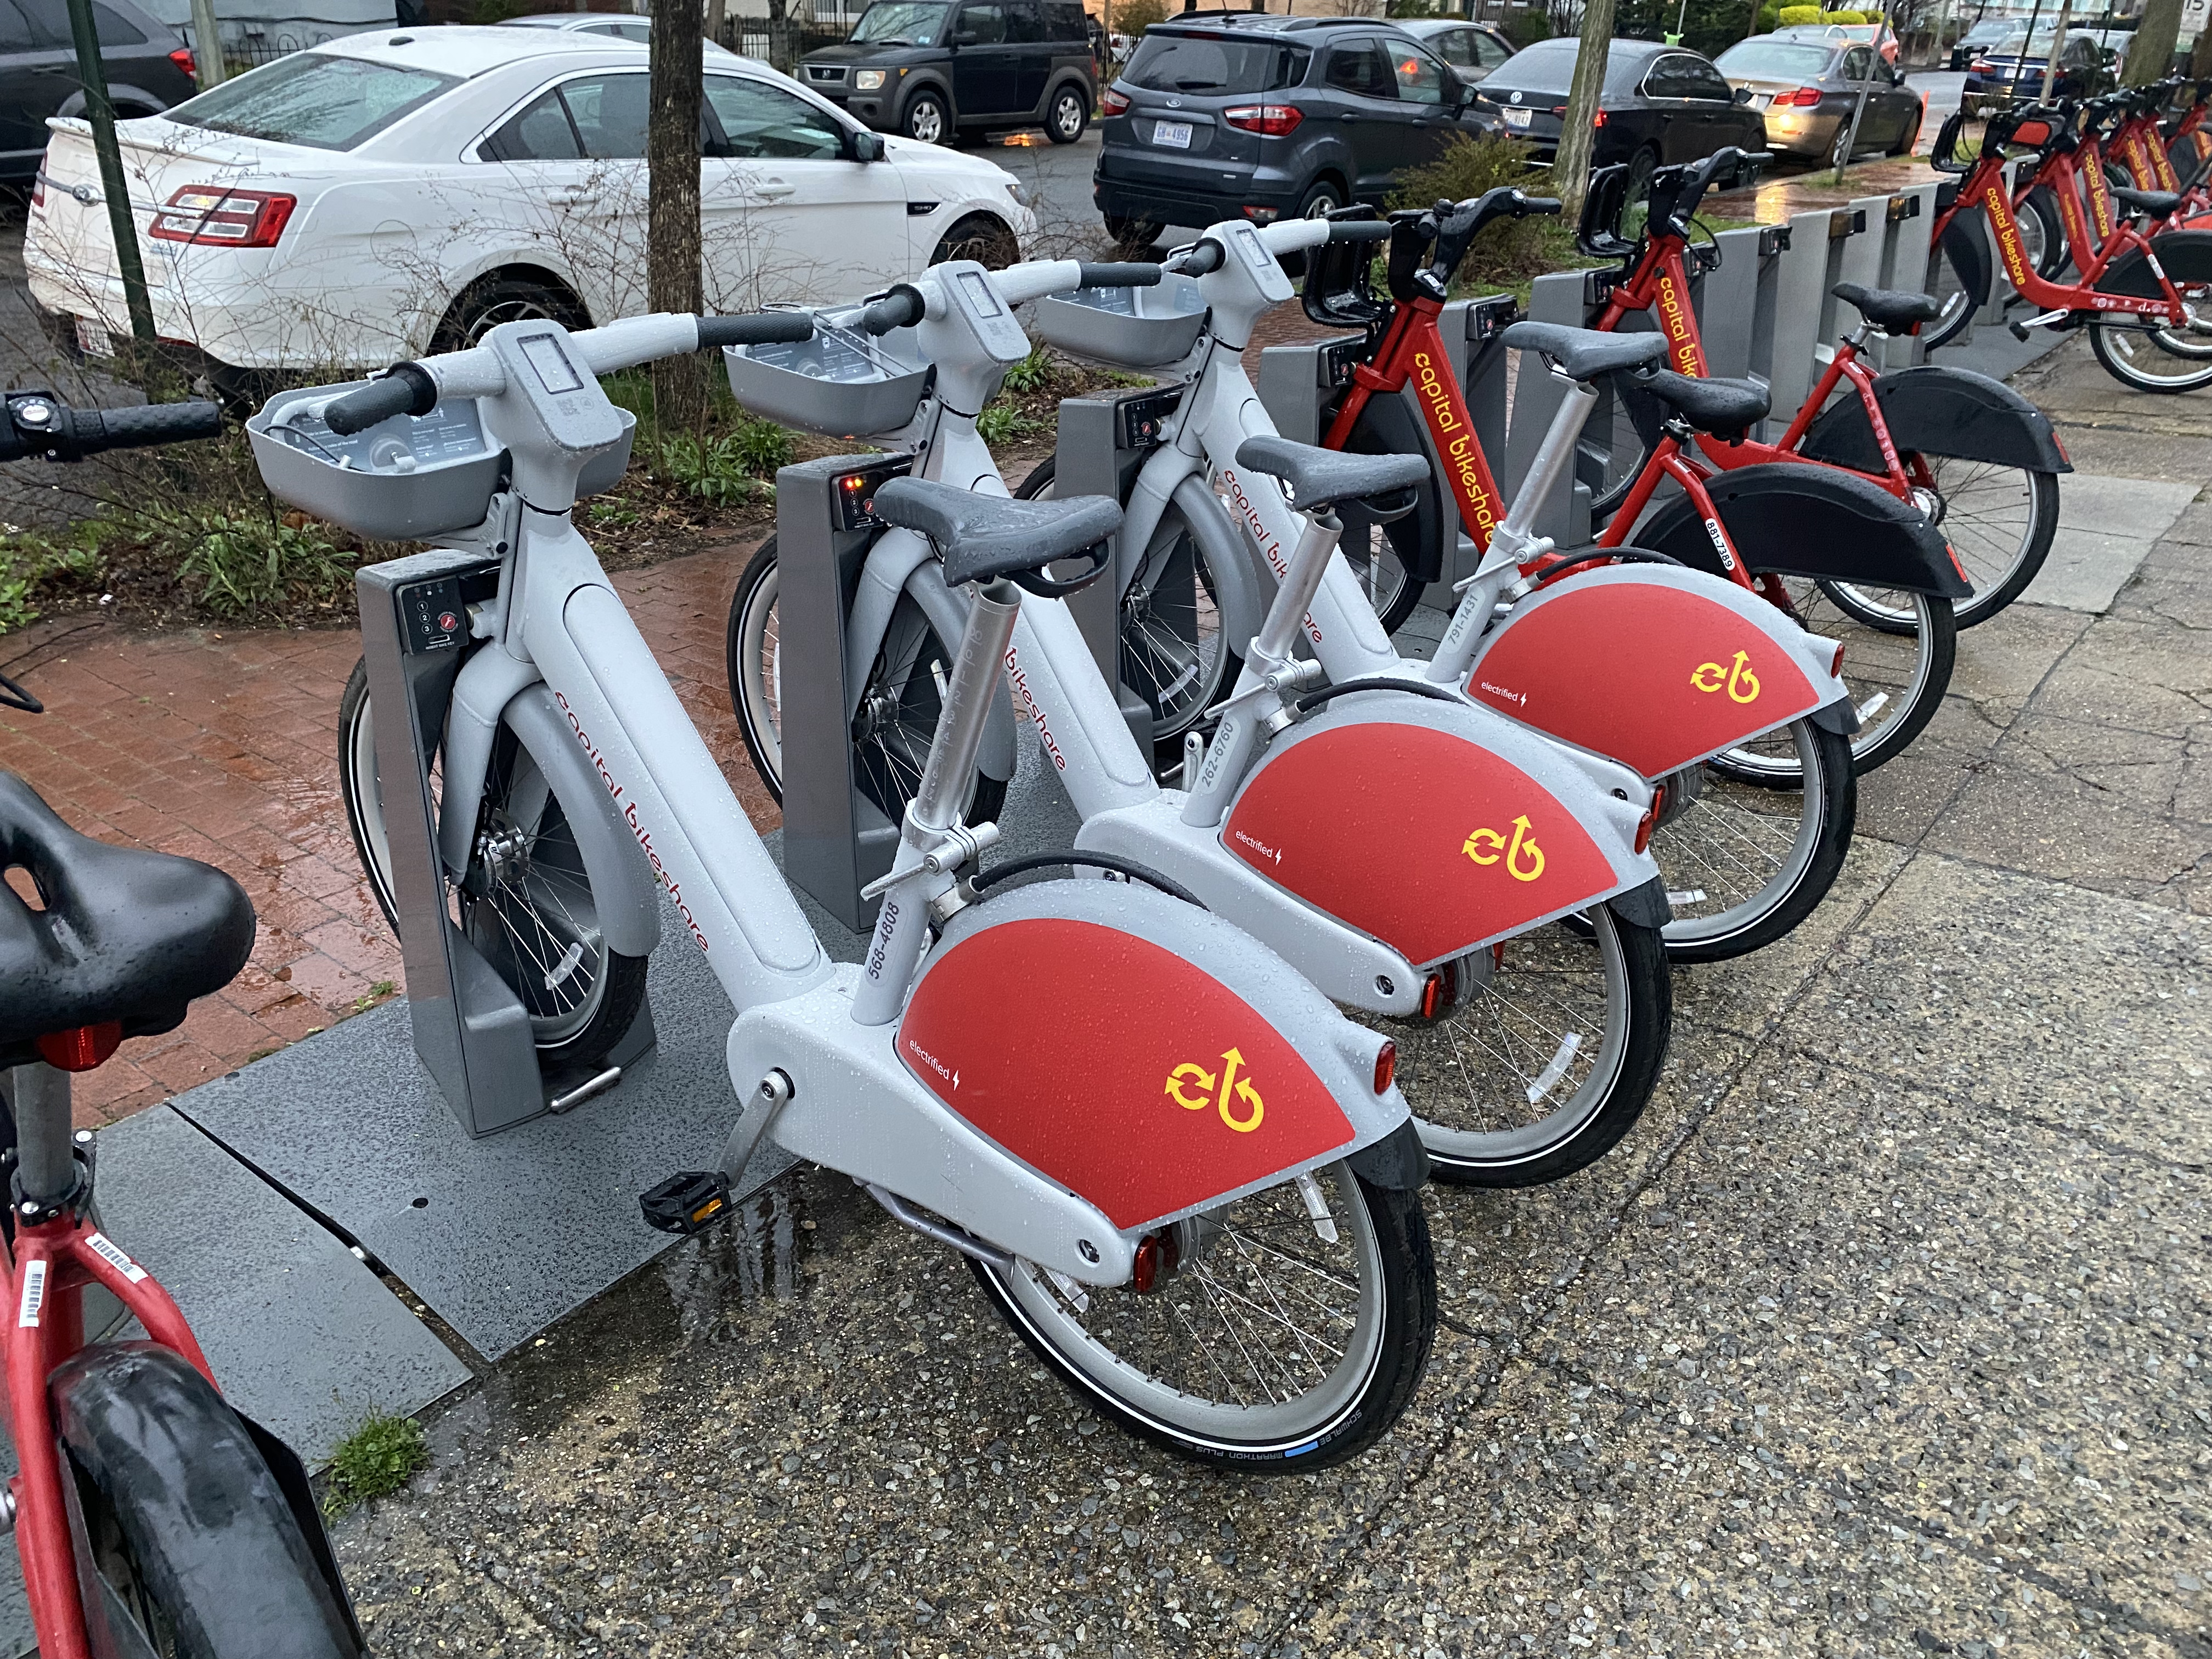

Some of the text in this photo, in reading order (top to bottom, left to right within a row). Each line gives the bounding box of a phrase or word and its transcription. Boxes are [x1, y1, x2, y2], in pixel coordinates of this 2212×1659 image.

[1987, 187, 2025, 285] capital bikeshare
[1661, 278, 1691, 341] capital
[1415, 353, 1462, 433] capital
[1224, 470, 1271, 542] capital
[1707, 522, 1733, 567] 881-7389
[1448, 594, 1478, 645] 791-1431
[1005, 647, 1065, 771] bikeshare
[1481, 681, 1519, 702] electrified
[1201, 722, 1233, 788] 262-6760
[555, 692, 709, 951] capital bikeshare
[1235, 830, 1273, 858] electrified
[869, 901, 900, 980] 568-4808
[910, 1040, 950, 1080] electrified
[1195, 1446, 1283, 1460] MARATHON PLUS
[1319, 1408, 1363, 1446] SCHWALBE
